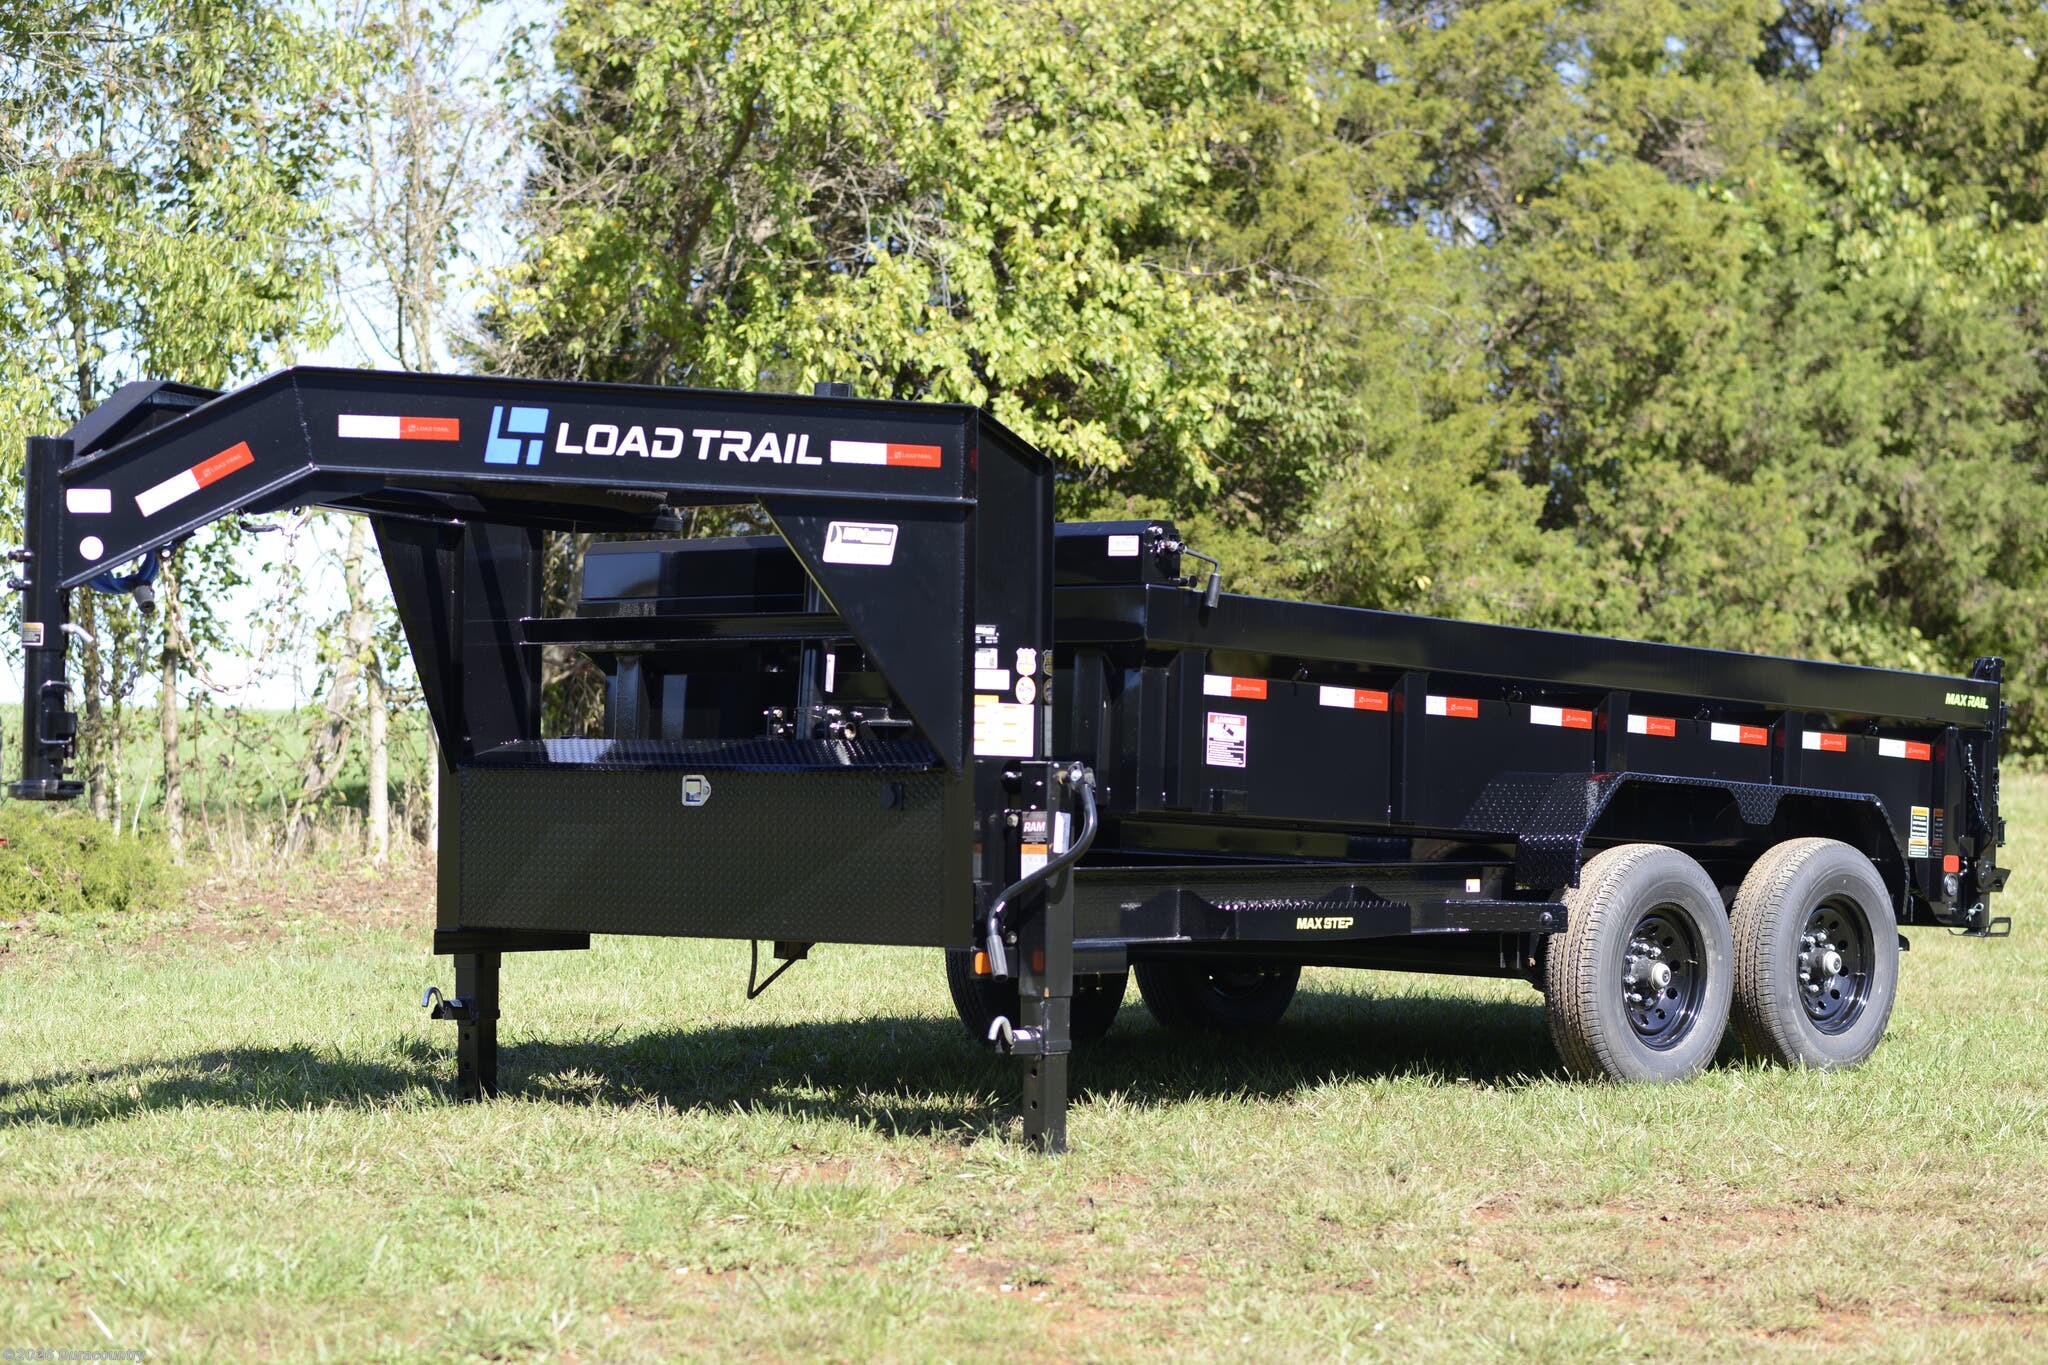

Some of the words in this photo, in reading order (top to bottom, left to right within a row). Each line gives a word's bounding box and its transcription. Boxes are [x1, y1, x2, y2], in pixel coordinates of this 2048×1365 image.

[555, 422, 684, 458] LOAD
[692, 429, 822, 465] TRAIL
[1945, 692, 1967, 707] MAX
[1967, 695, 1989, 710] RAIL
[1023, 821, 1047, 833] RAM
[1296, 917, 1323, 930] MAX
[1323, 916, 1354, 929] STEP
